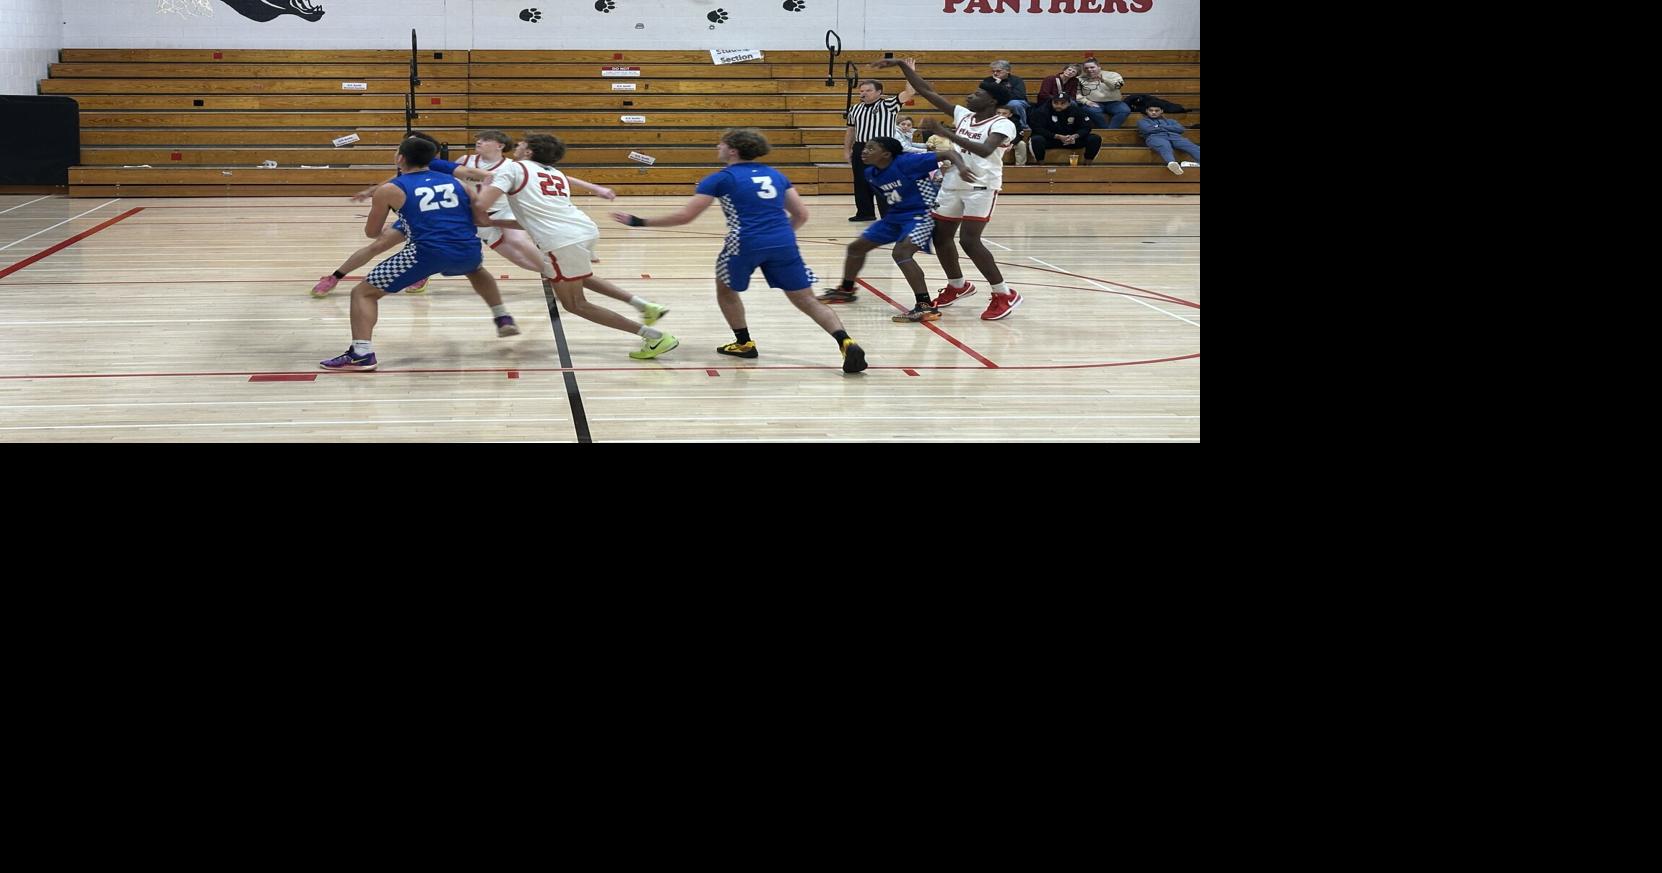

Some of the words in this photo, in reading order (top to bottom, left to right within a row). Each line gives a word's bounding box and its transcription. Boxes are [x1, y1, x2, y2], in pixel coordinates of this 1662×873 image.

[720, 54, 753, 63] Section
[538, 172, 568, 197] 22
[750, 175, 778, 199] 3
[414, 183, 459, 212] 23
